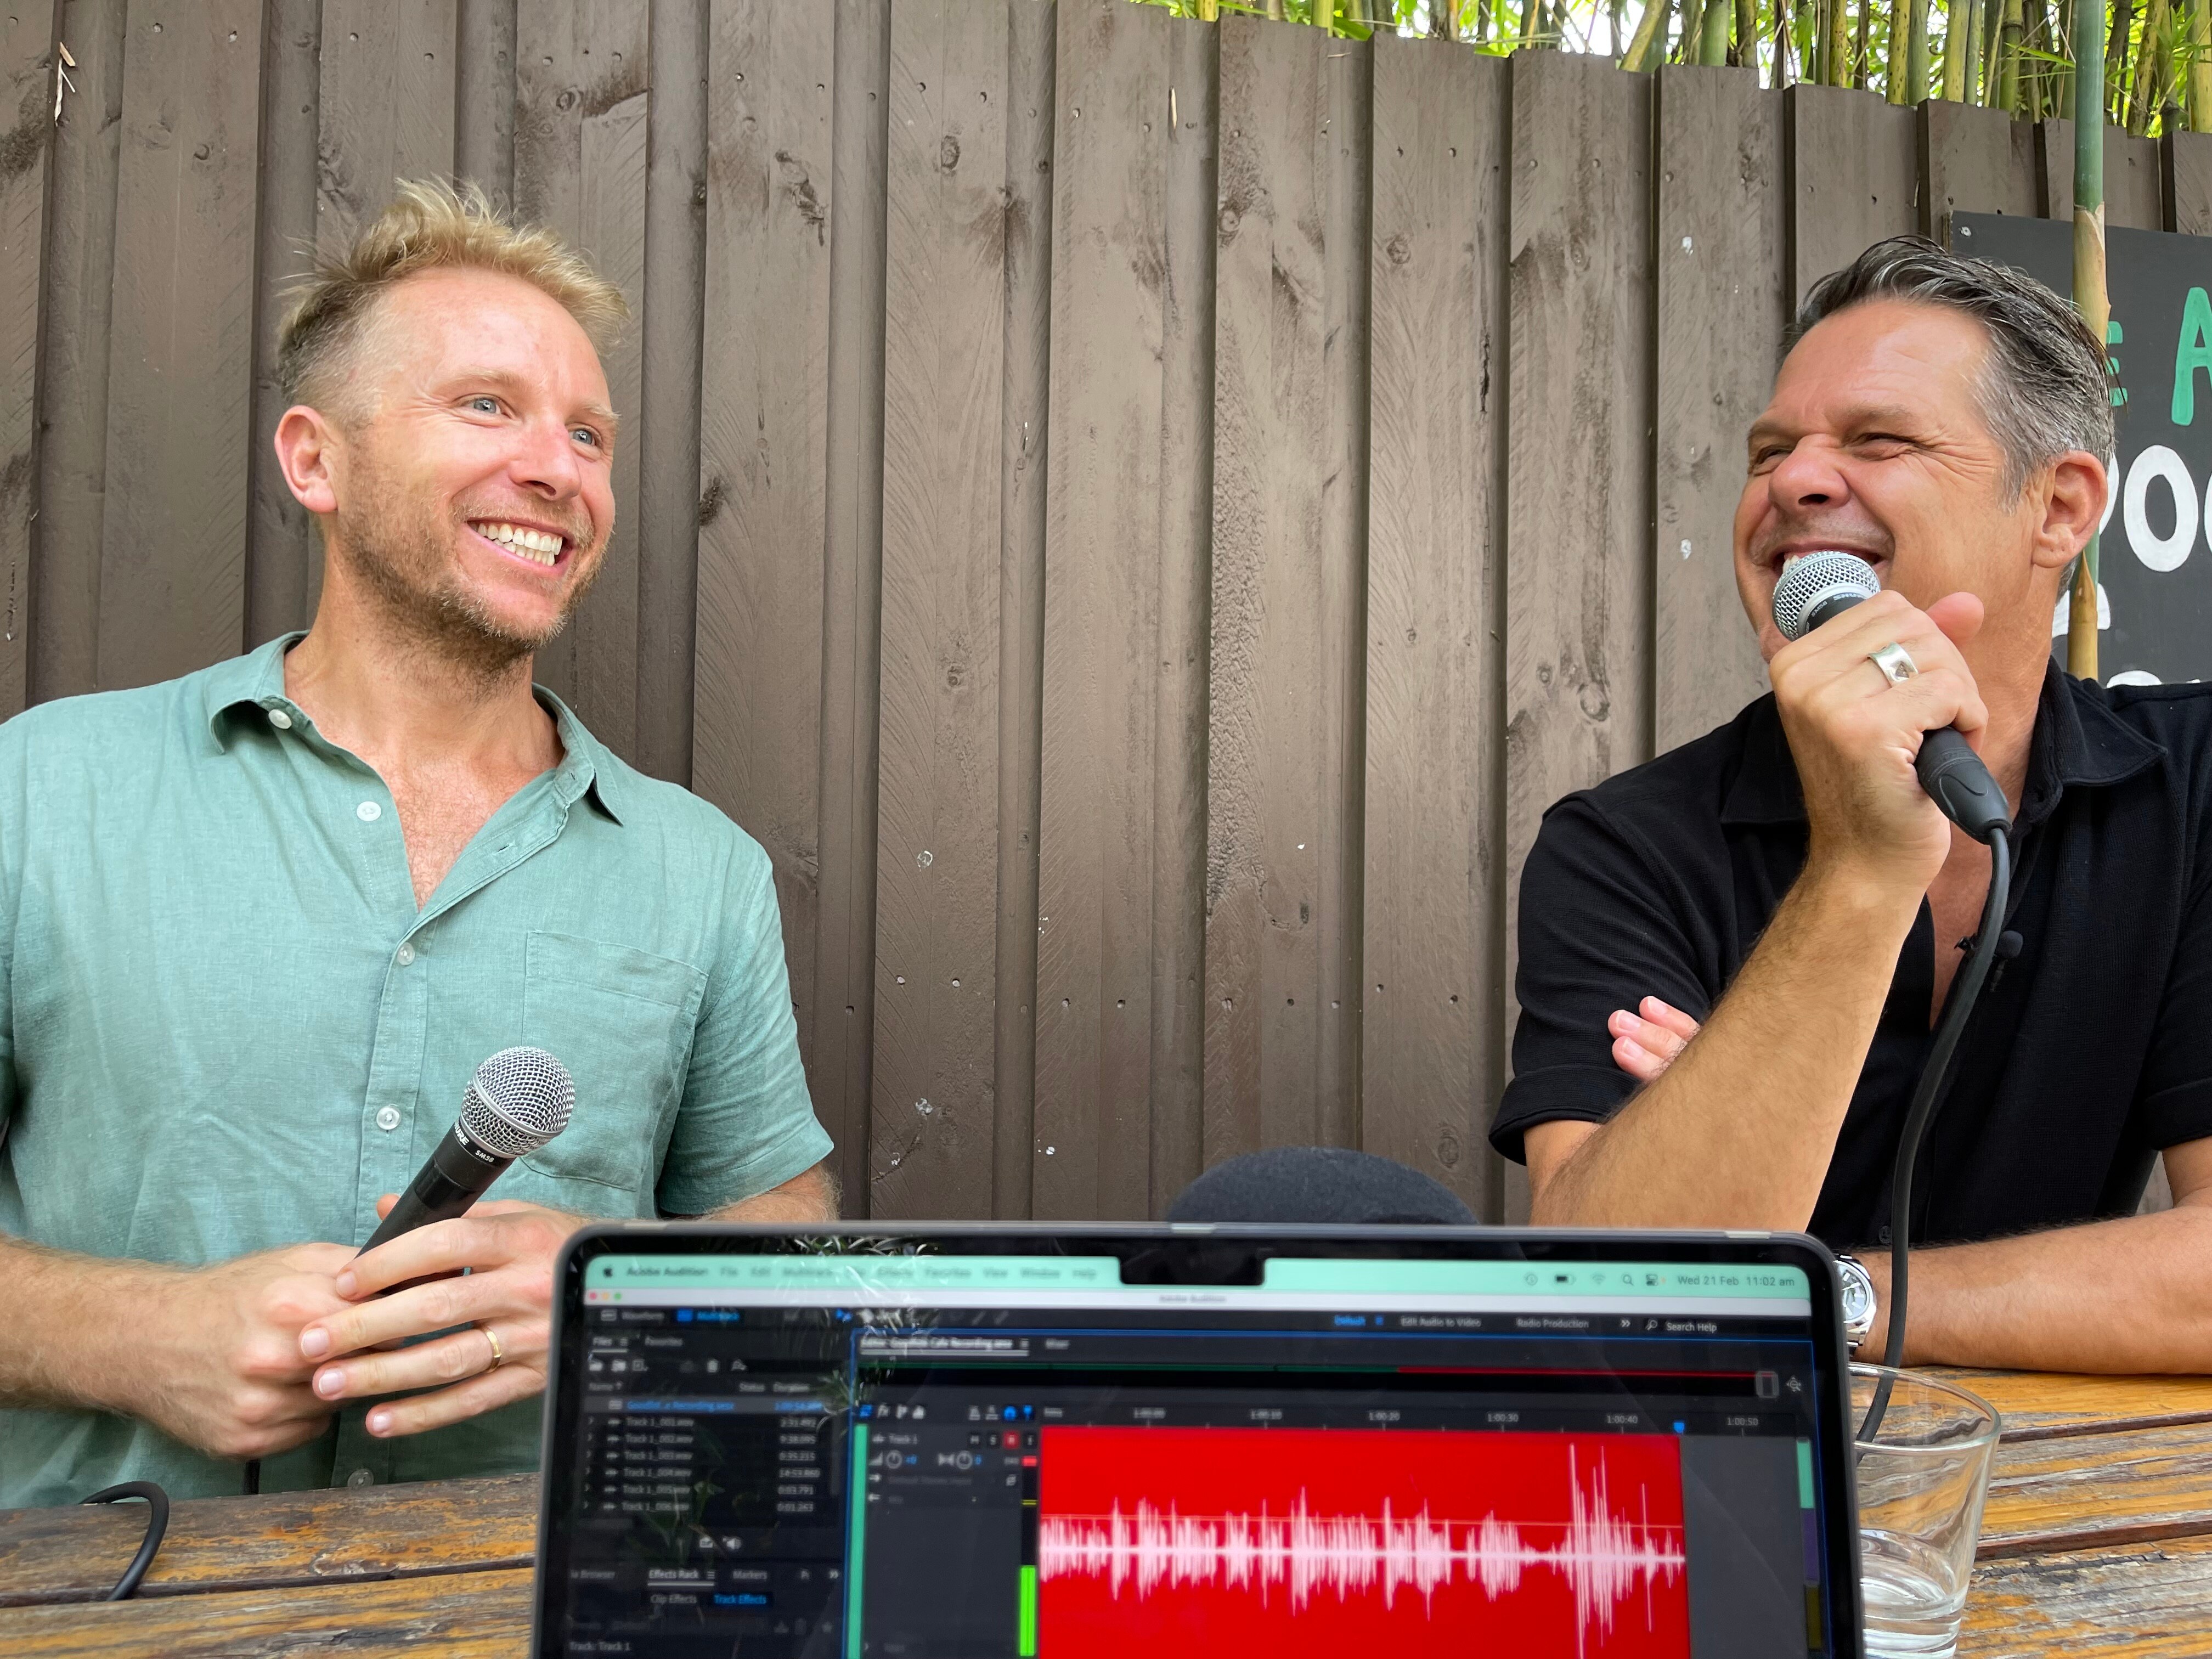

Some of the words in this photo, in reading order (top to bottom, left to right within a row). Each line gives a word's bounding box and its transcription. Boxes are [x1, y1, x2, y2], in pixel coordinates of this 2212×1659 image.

[454, 1120, 470, 1146] URE
[475, 1150, 494, 1163] SM58
[1678, 1276, 1700, 1285] Wed
[1704, 1277, 1716, 1285] 21
[1720, 1277, 1739, 1285] Feb
[1746, 1277, 1775, 1286] 11:02
[1419, 1316, 1444, 1327] Audio
[1445, 1317, 1454, 1327] to
[1456, 1317, 1481, 1327] Video
[1517, 1318, 1541, 1328] Radio
[1544, 1318, 1589, 1329] Production
[1666, 1322, 1695, 1332] Search
[1697, 1323, 1717, 1334] Help
[1488, 1413, 1519, 1423] 1:00:30
[1607, 1415, 1638, 1424] 1:00:40
[1727, 1417, 1758, 1426] 1:00:50
[649, 1569, 676, 1579] Effects
[679, 1570, 699, 1579] Rack
[732, 1570, 767, 1579] Markers
[669, 1594, 697, 1604] Effects
[715, 1595, 736, 1604] Track
[739, 1595, 766, 1604] Effects
